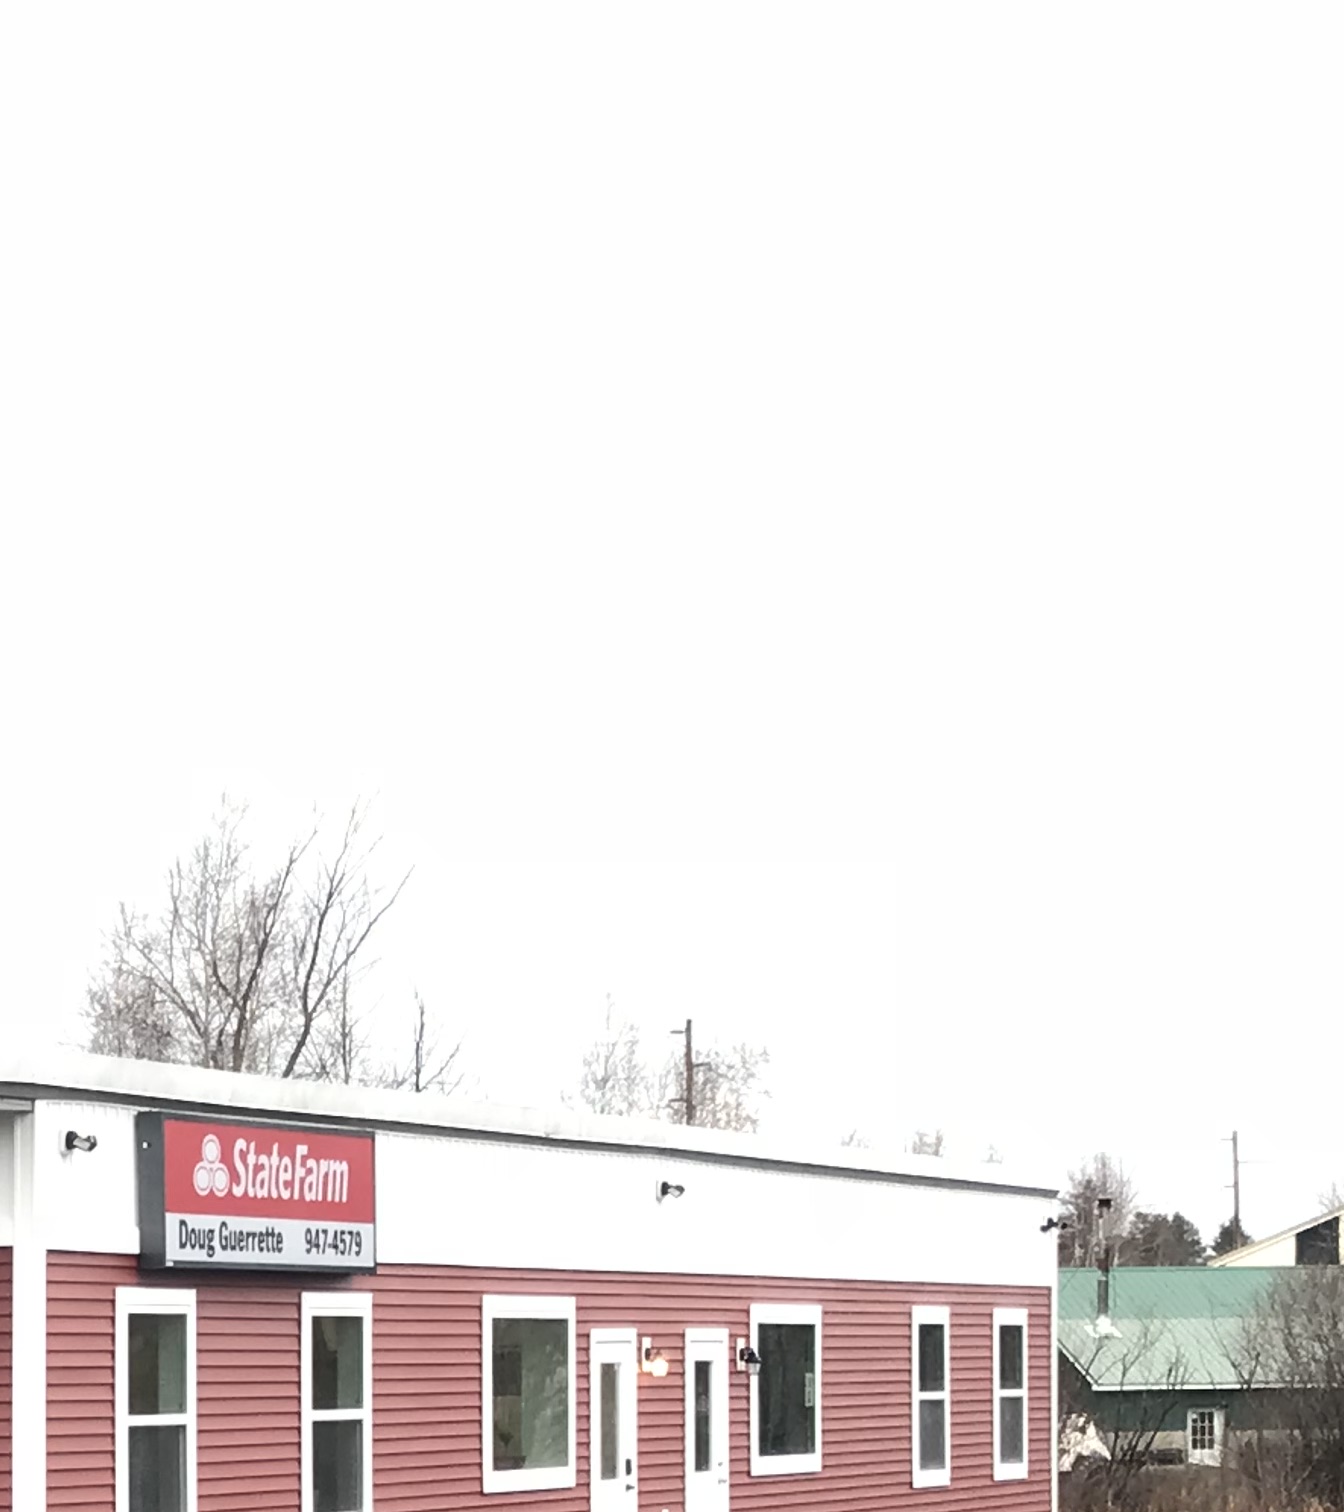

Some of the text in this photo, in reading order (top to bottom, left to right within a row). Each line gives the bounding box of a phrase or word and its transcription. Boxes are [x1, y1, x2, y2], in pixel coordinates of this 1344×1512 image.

[178, 1219, 363, 1258] Doug Guerrette 947-4579
